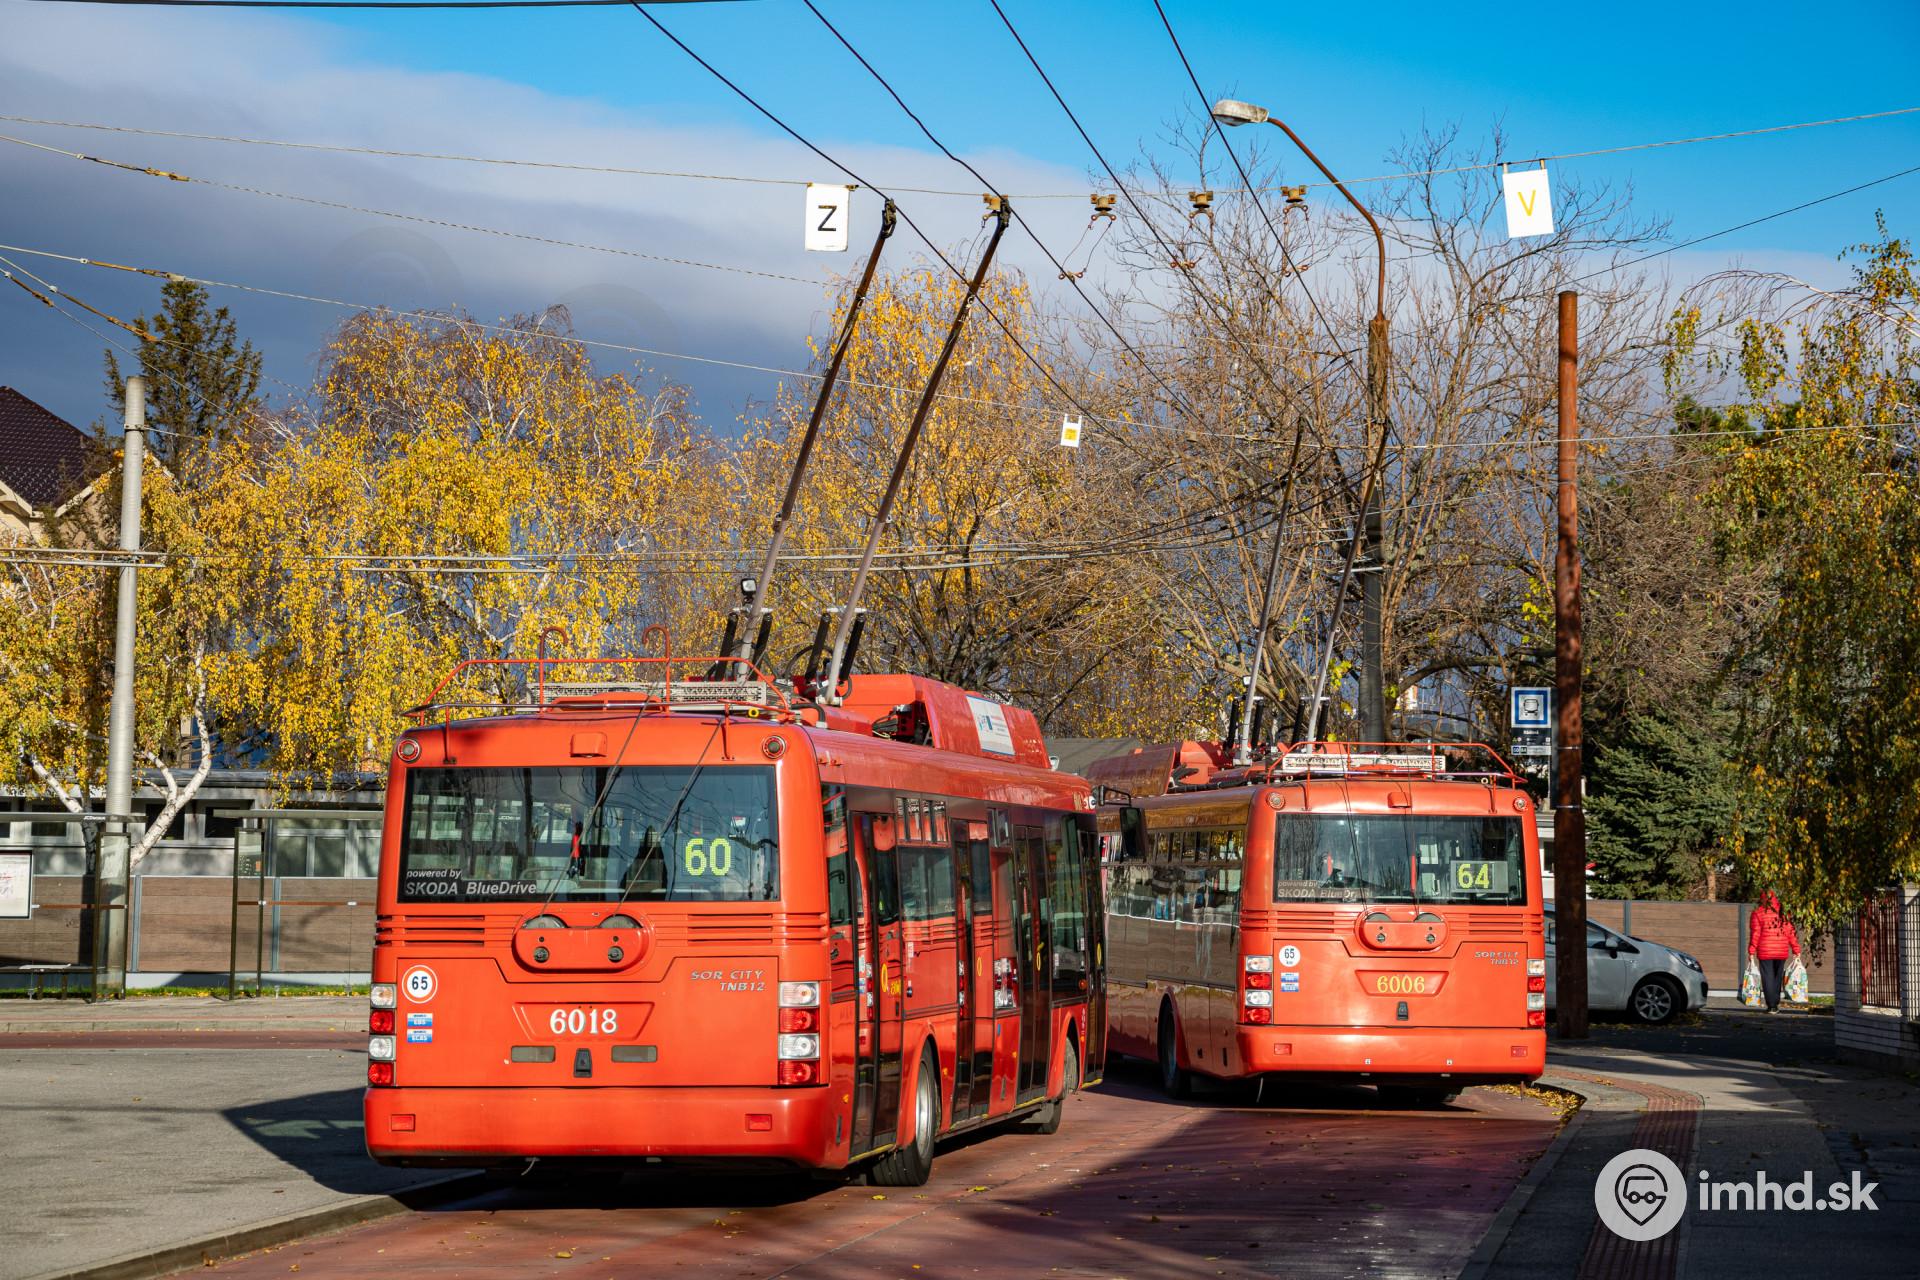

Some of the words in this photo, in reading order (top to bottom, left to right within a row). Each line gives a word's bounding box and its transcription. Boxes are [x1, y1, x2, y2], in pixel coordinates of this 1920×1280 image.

[1517, 188, 1536, 217] V
[817, 204, 838, 232] Z
[685, 838, 731, 876] 60
[406, 868, 449, 880] powered
[449, 868, 462, 881] by
[1458, 863, 1490, 889] 64
[466, 881, 537, 894] BlueDrive
[1284, 948, 1295, 959] 65
[411, 976, 428, 990] 65
[691, 970, 723, 980] SOR
[730, 969, 764, 980] CITY
[1377, 976, 1425, 993] 6006
[550, 1008, 618, 1035] 6018
